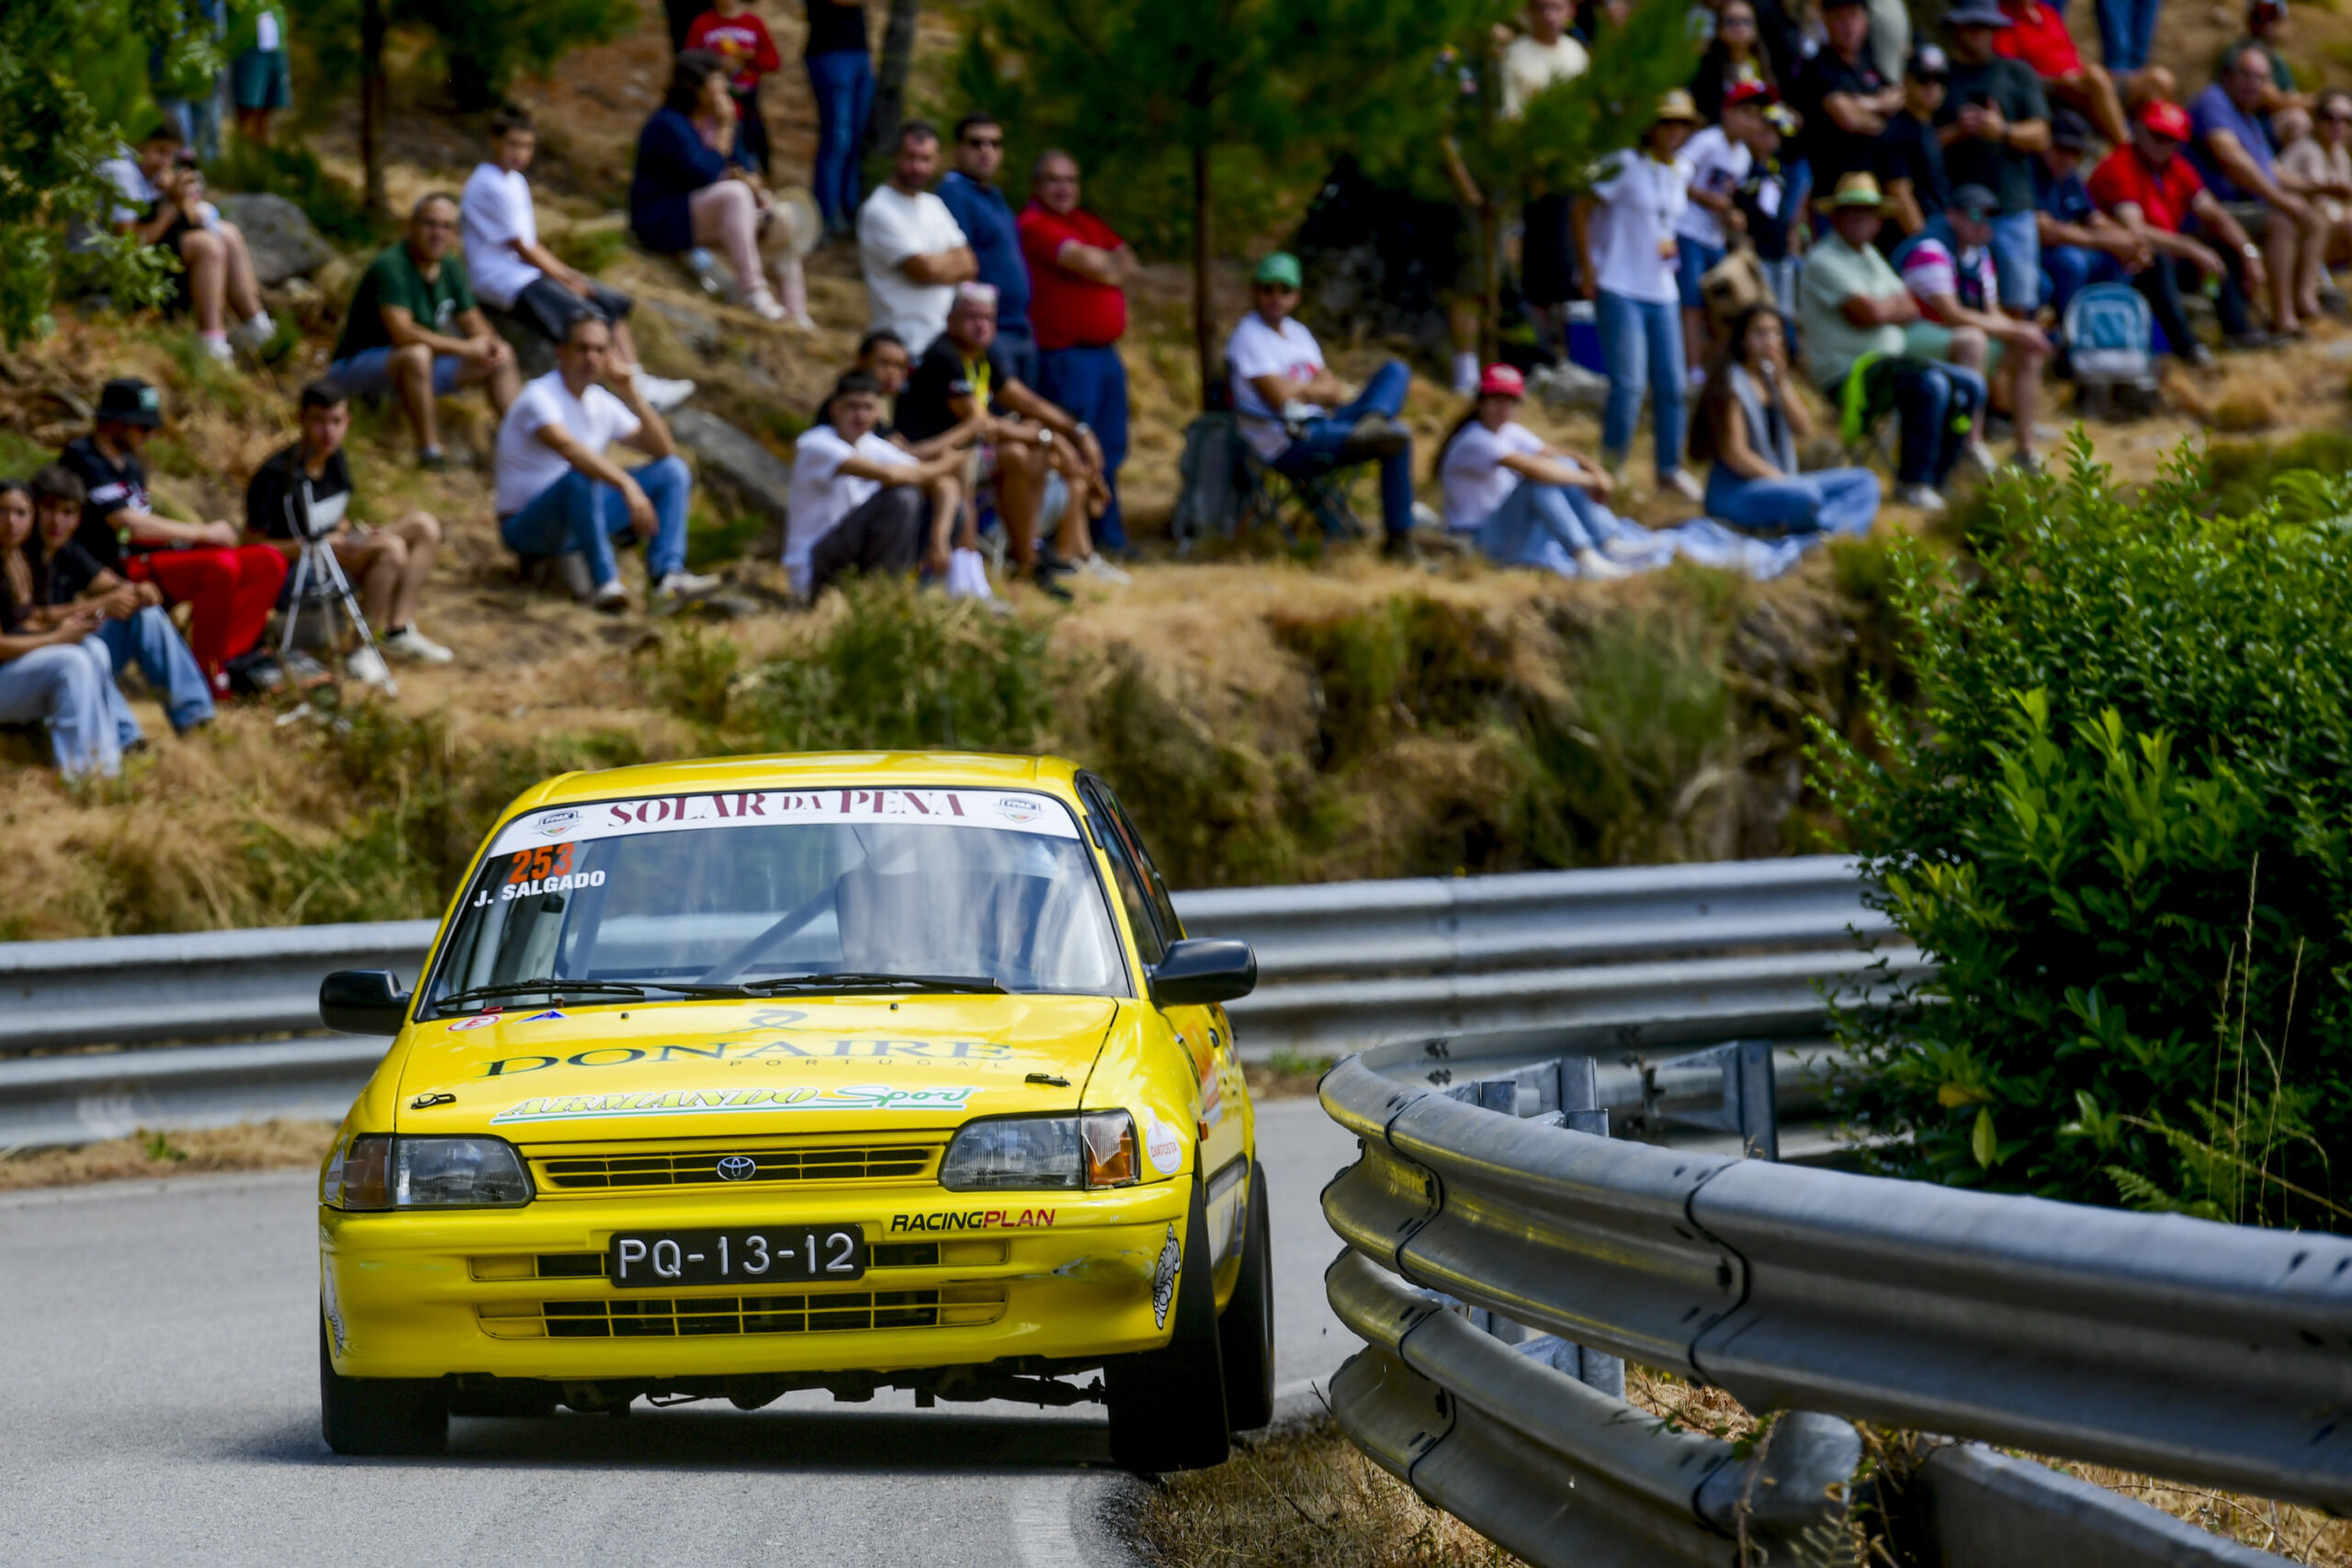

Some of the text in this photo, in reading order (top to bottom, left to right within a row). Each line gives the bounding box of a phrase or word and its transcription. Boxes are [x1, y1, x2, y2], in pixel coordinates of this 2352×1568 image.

[609, 791, 966, 827] SOLAR DA PENA
[509, 841, 575, 884] 253
[473, 870, 606, 908] J. SALGADO
[464, 1017, 489, 1027] E
[476, 1040, 1012, 1077] DONAIRE
[729, 1058, 1006, 1068] PORTUGAL
[499, 1086, 974, 1118] ARMANDO Sport
[890, 1208, 1057, 1233] RACINGPLAN
[617, 1231, 855, 1280] PQ-13-12
